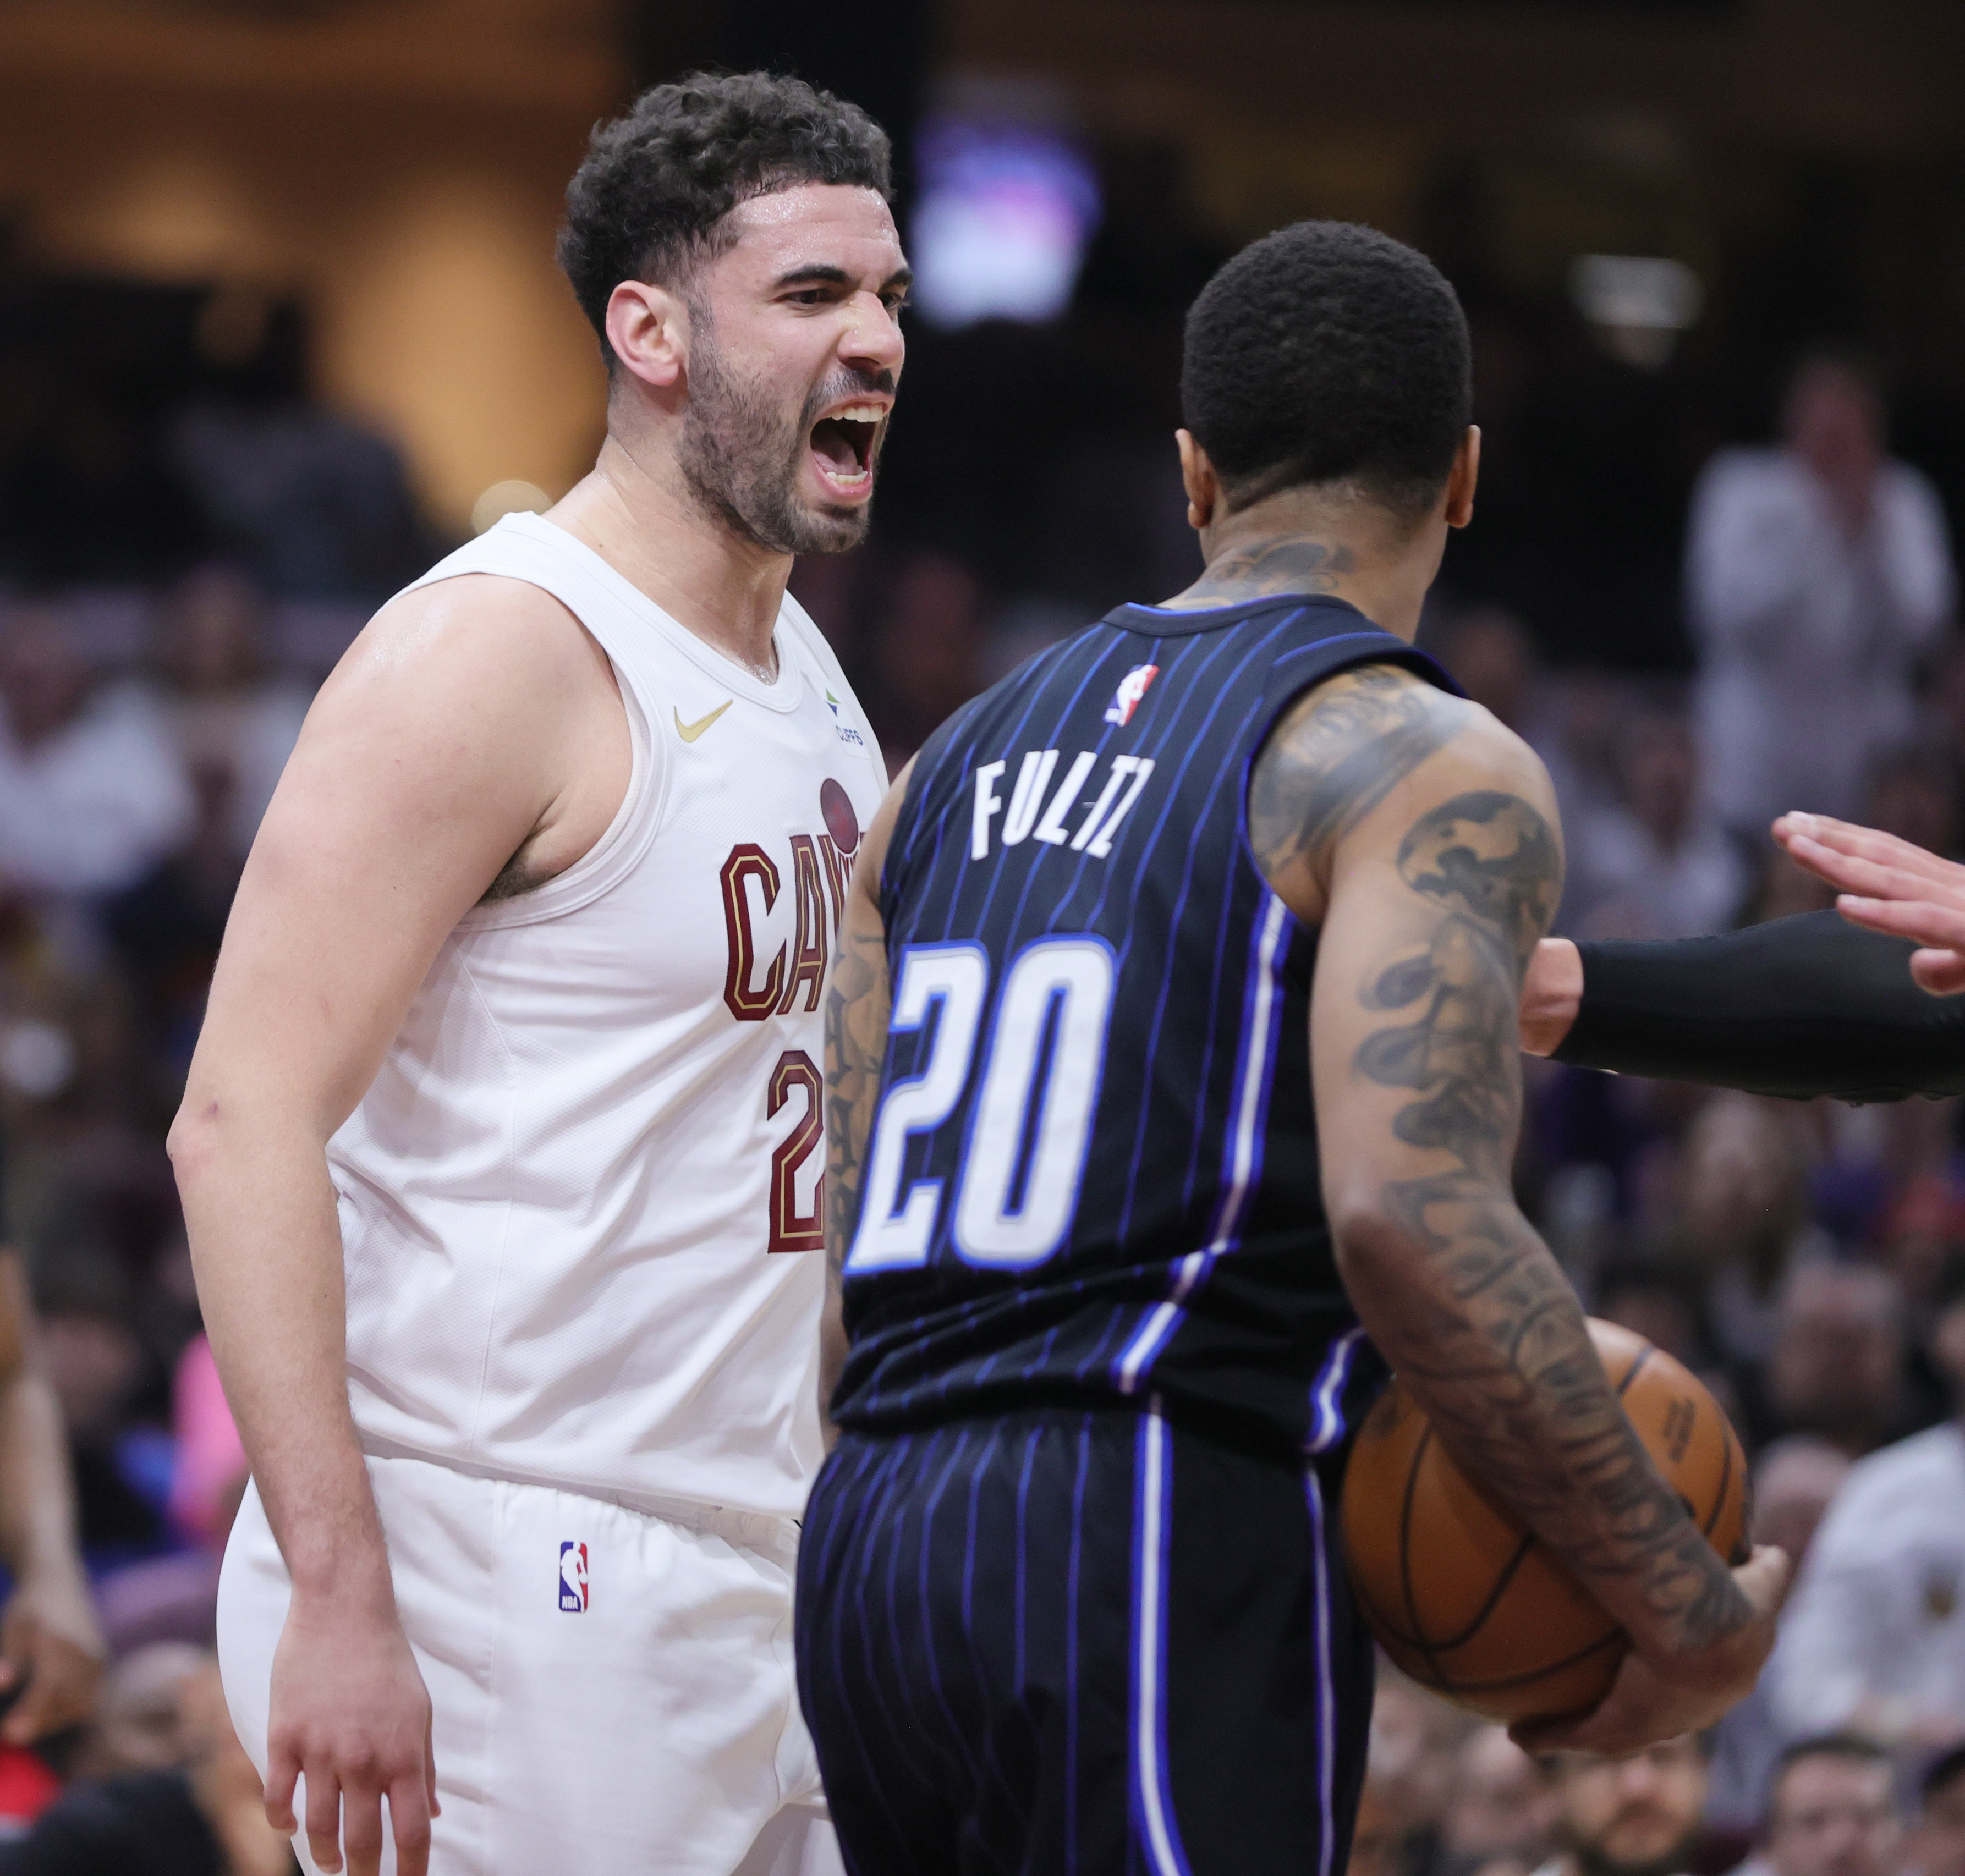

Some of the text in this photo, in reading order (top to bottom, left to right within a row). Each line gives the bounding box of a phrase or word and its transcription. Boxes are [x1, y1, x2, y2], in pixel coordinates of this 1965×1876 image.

[836, 725, 863, 745] CLIFFS
[971, 749, 1156, 861] FULTZ
[767, 1050, 825, 1254] 2
[841, 932, 1118, 1274] 20
[562, 1596, 578, 1609] NBA
